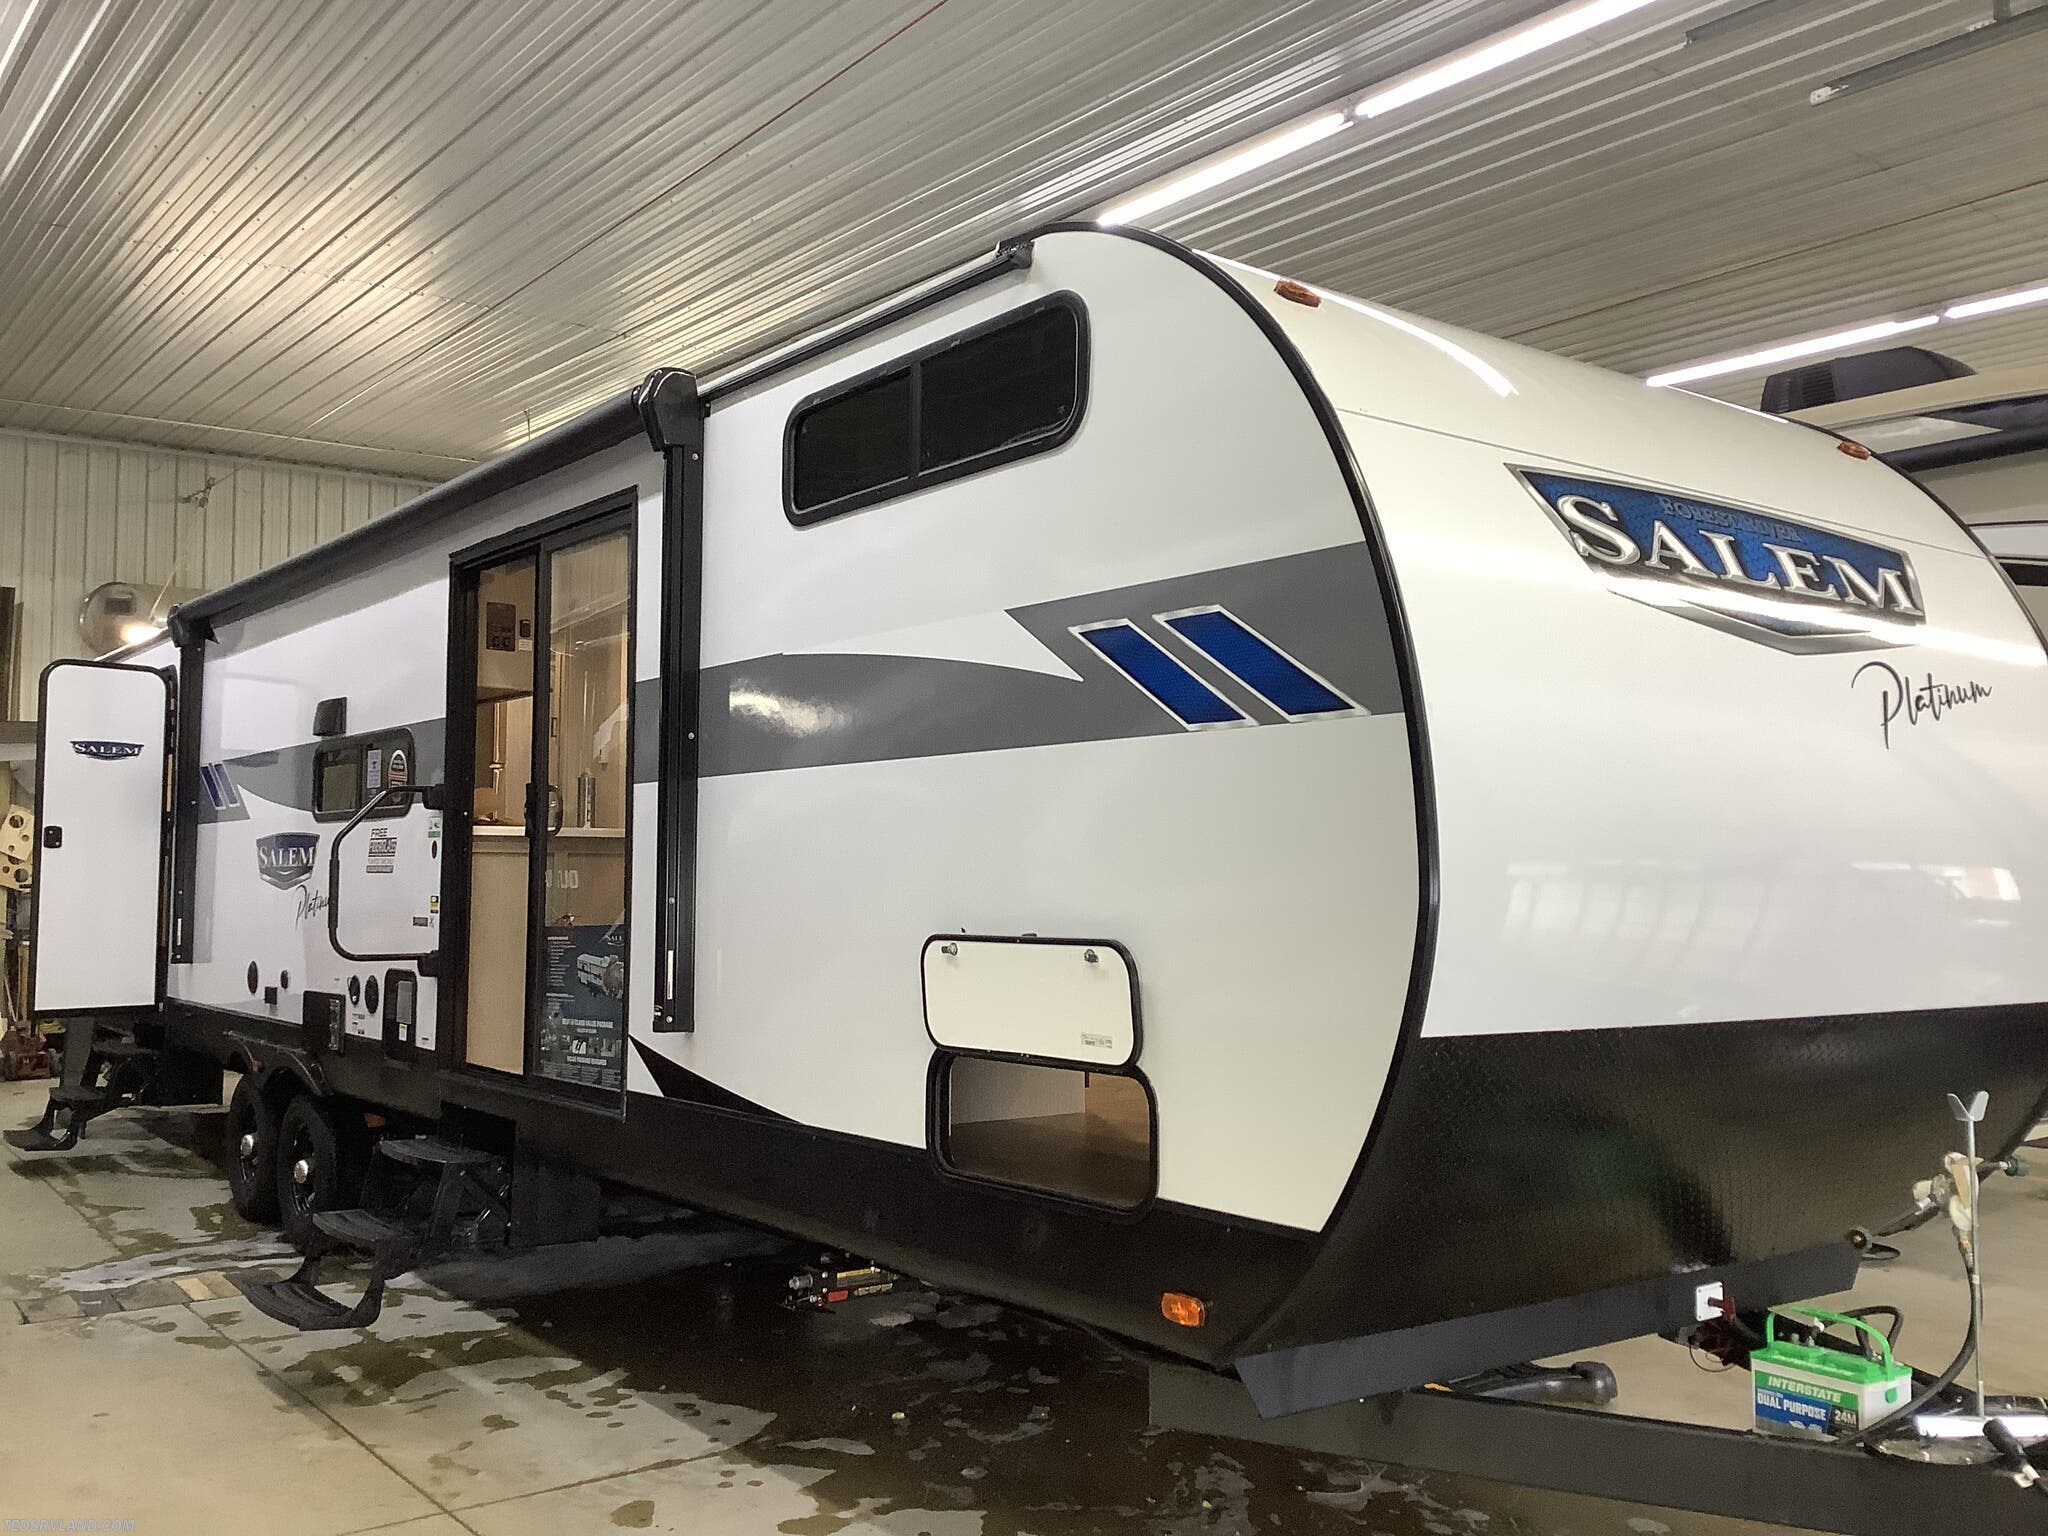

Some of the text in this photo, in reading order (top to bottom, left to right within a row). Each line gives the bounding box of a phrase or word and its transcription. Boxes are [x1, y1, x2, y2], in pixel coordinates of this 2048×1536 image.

[1556, 493, 1925, 616] SALEM
[1851, 661, 1992, 749] Platinum
[74, 742, 140, 755] SALEM
[259, 845, 316, 869] SALEM
[1768, 1375, 1842, 1403] INTERSTATE
[1757, 1392, 1782, 1410] DUAL
[1783, 1398, 1827, 1421] PURPOSE
[1834, 1409, 1857, 1425] 24M
